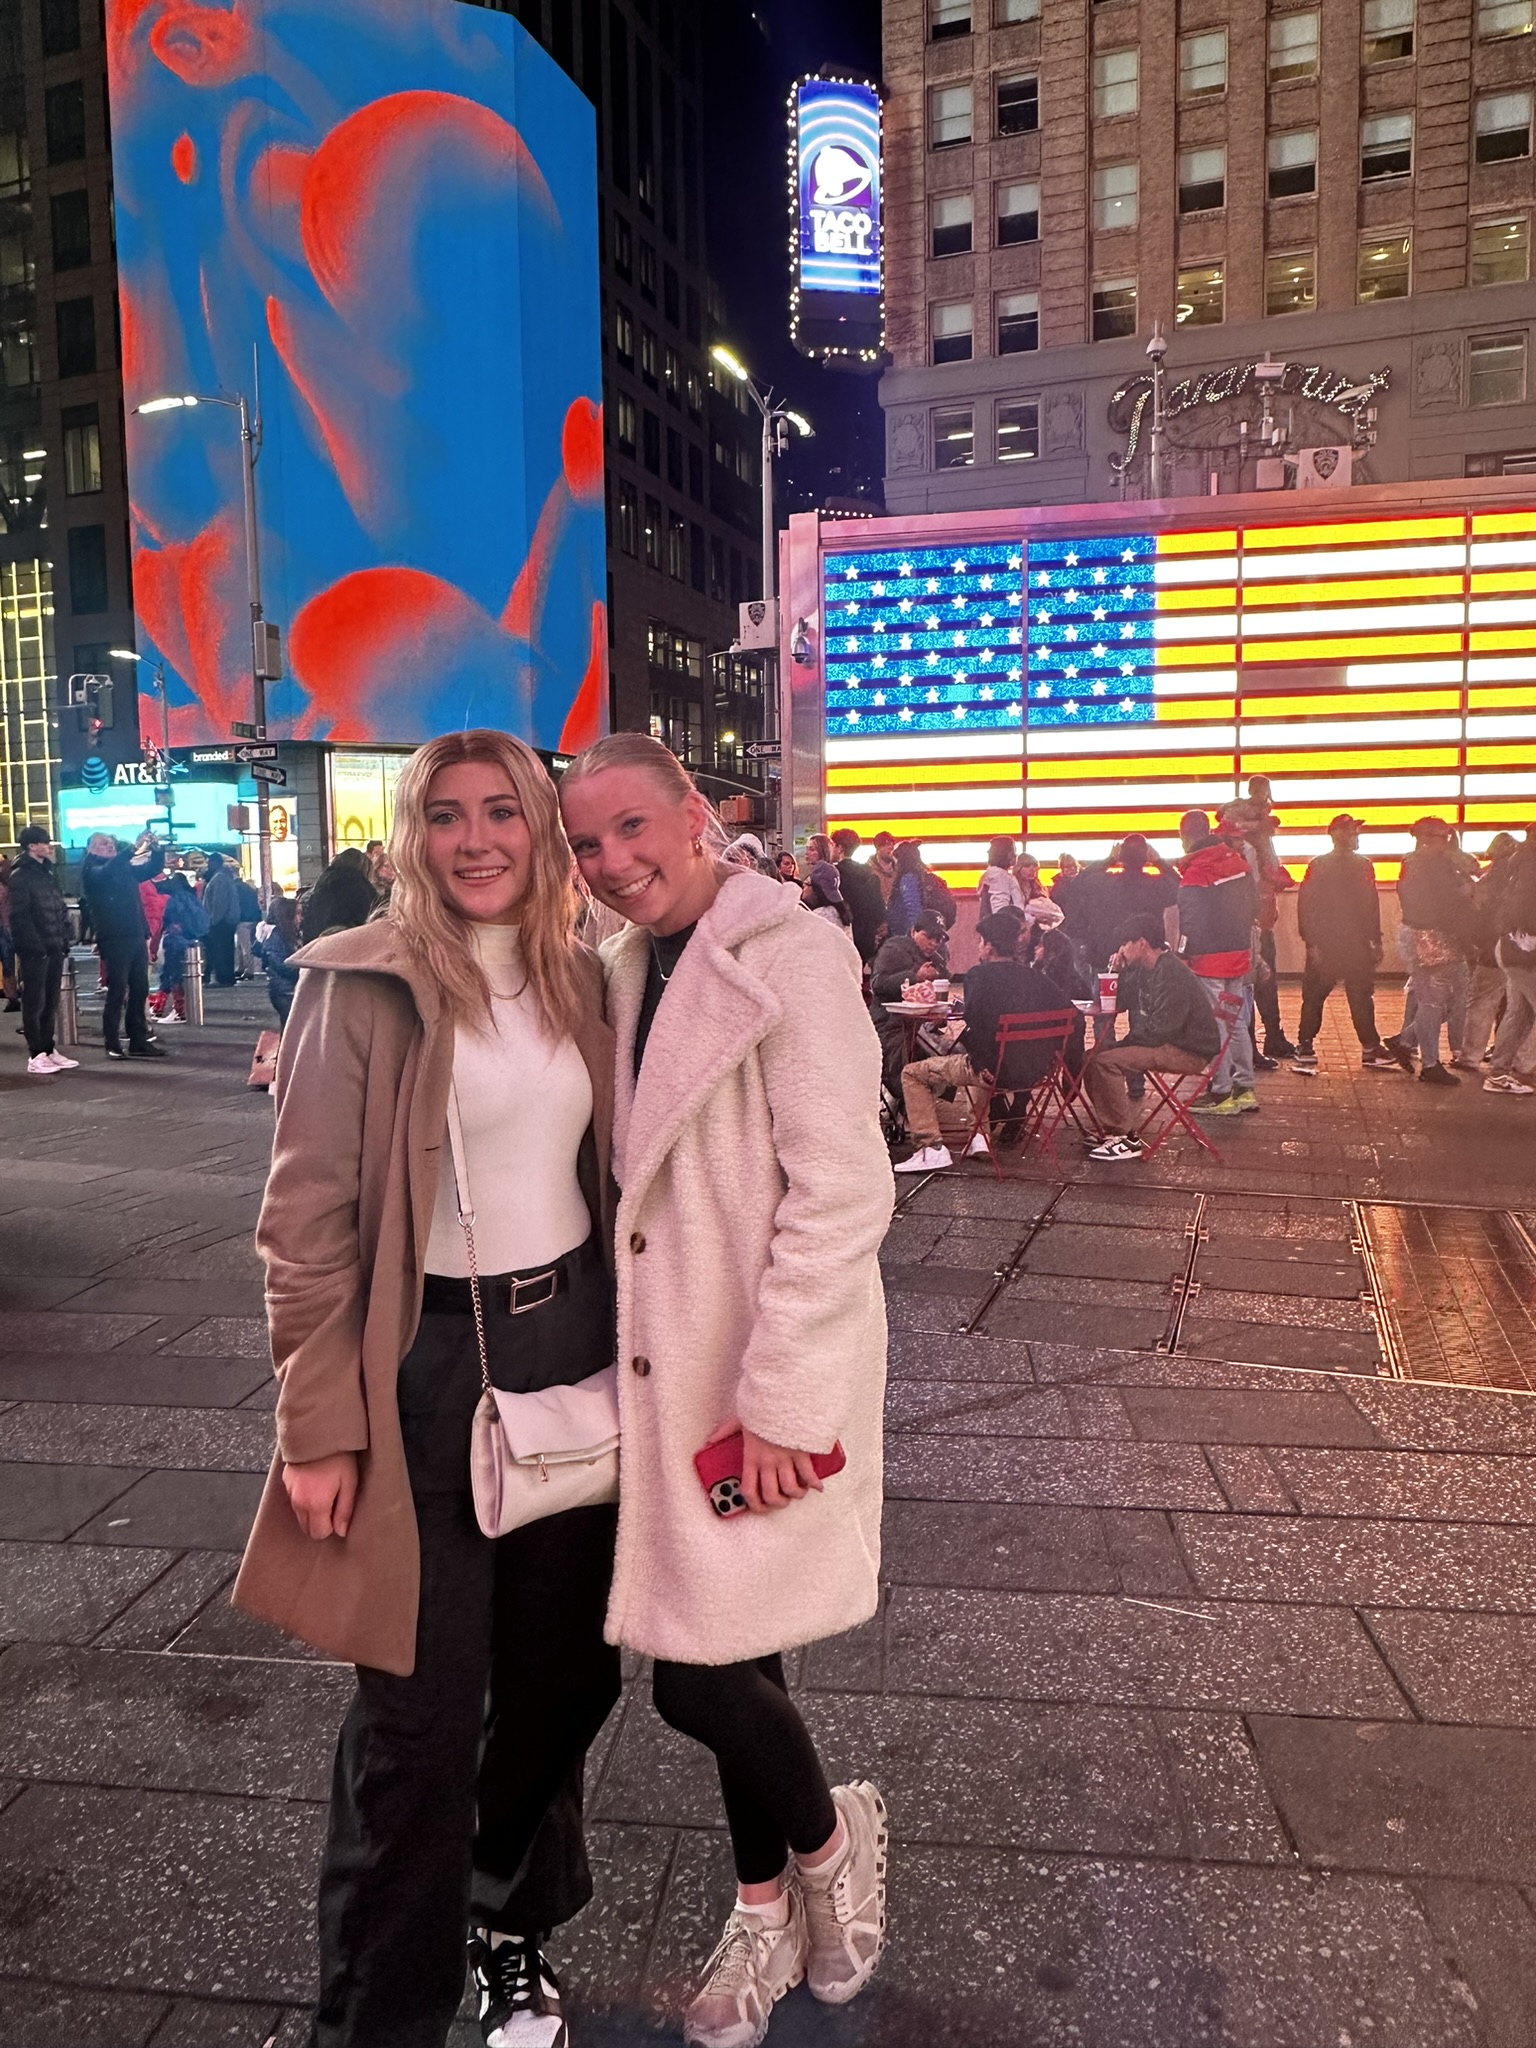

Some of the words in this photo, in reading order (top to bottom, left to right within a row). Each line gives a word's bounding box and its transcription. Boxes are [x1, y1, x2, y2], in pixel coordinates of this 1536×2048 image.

[809, 209, 872, 236] TACO
[814, 231, 873, 256] BELL
[193, 750, 229, 762] branded
[114, 762, 166, 785] AT&T
